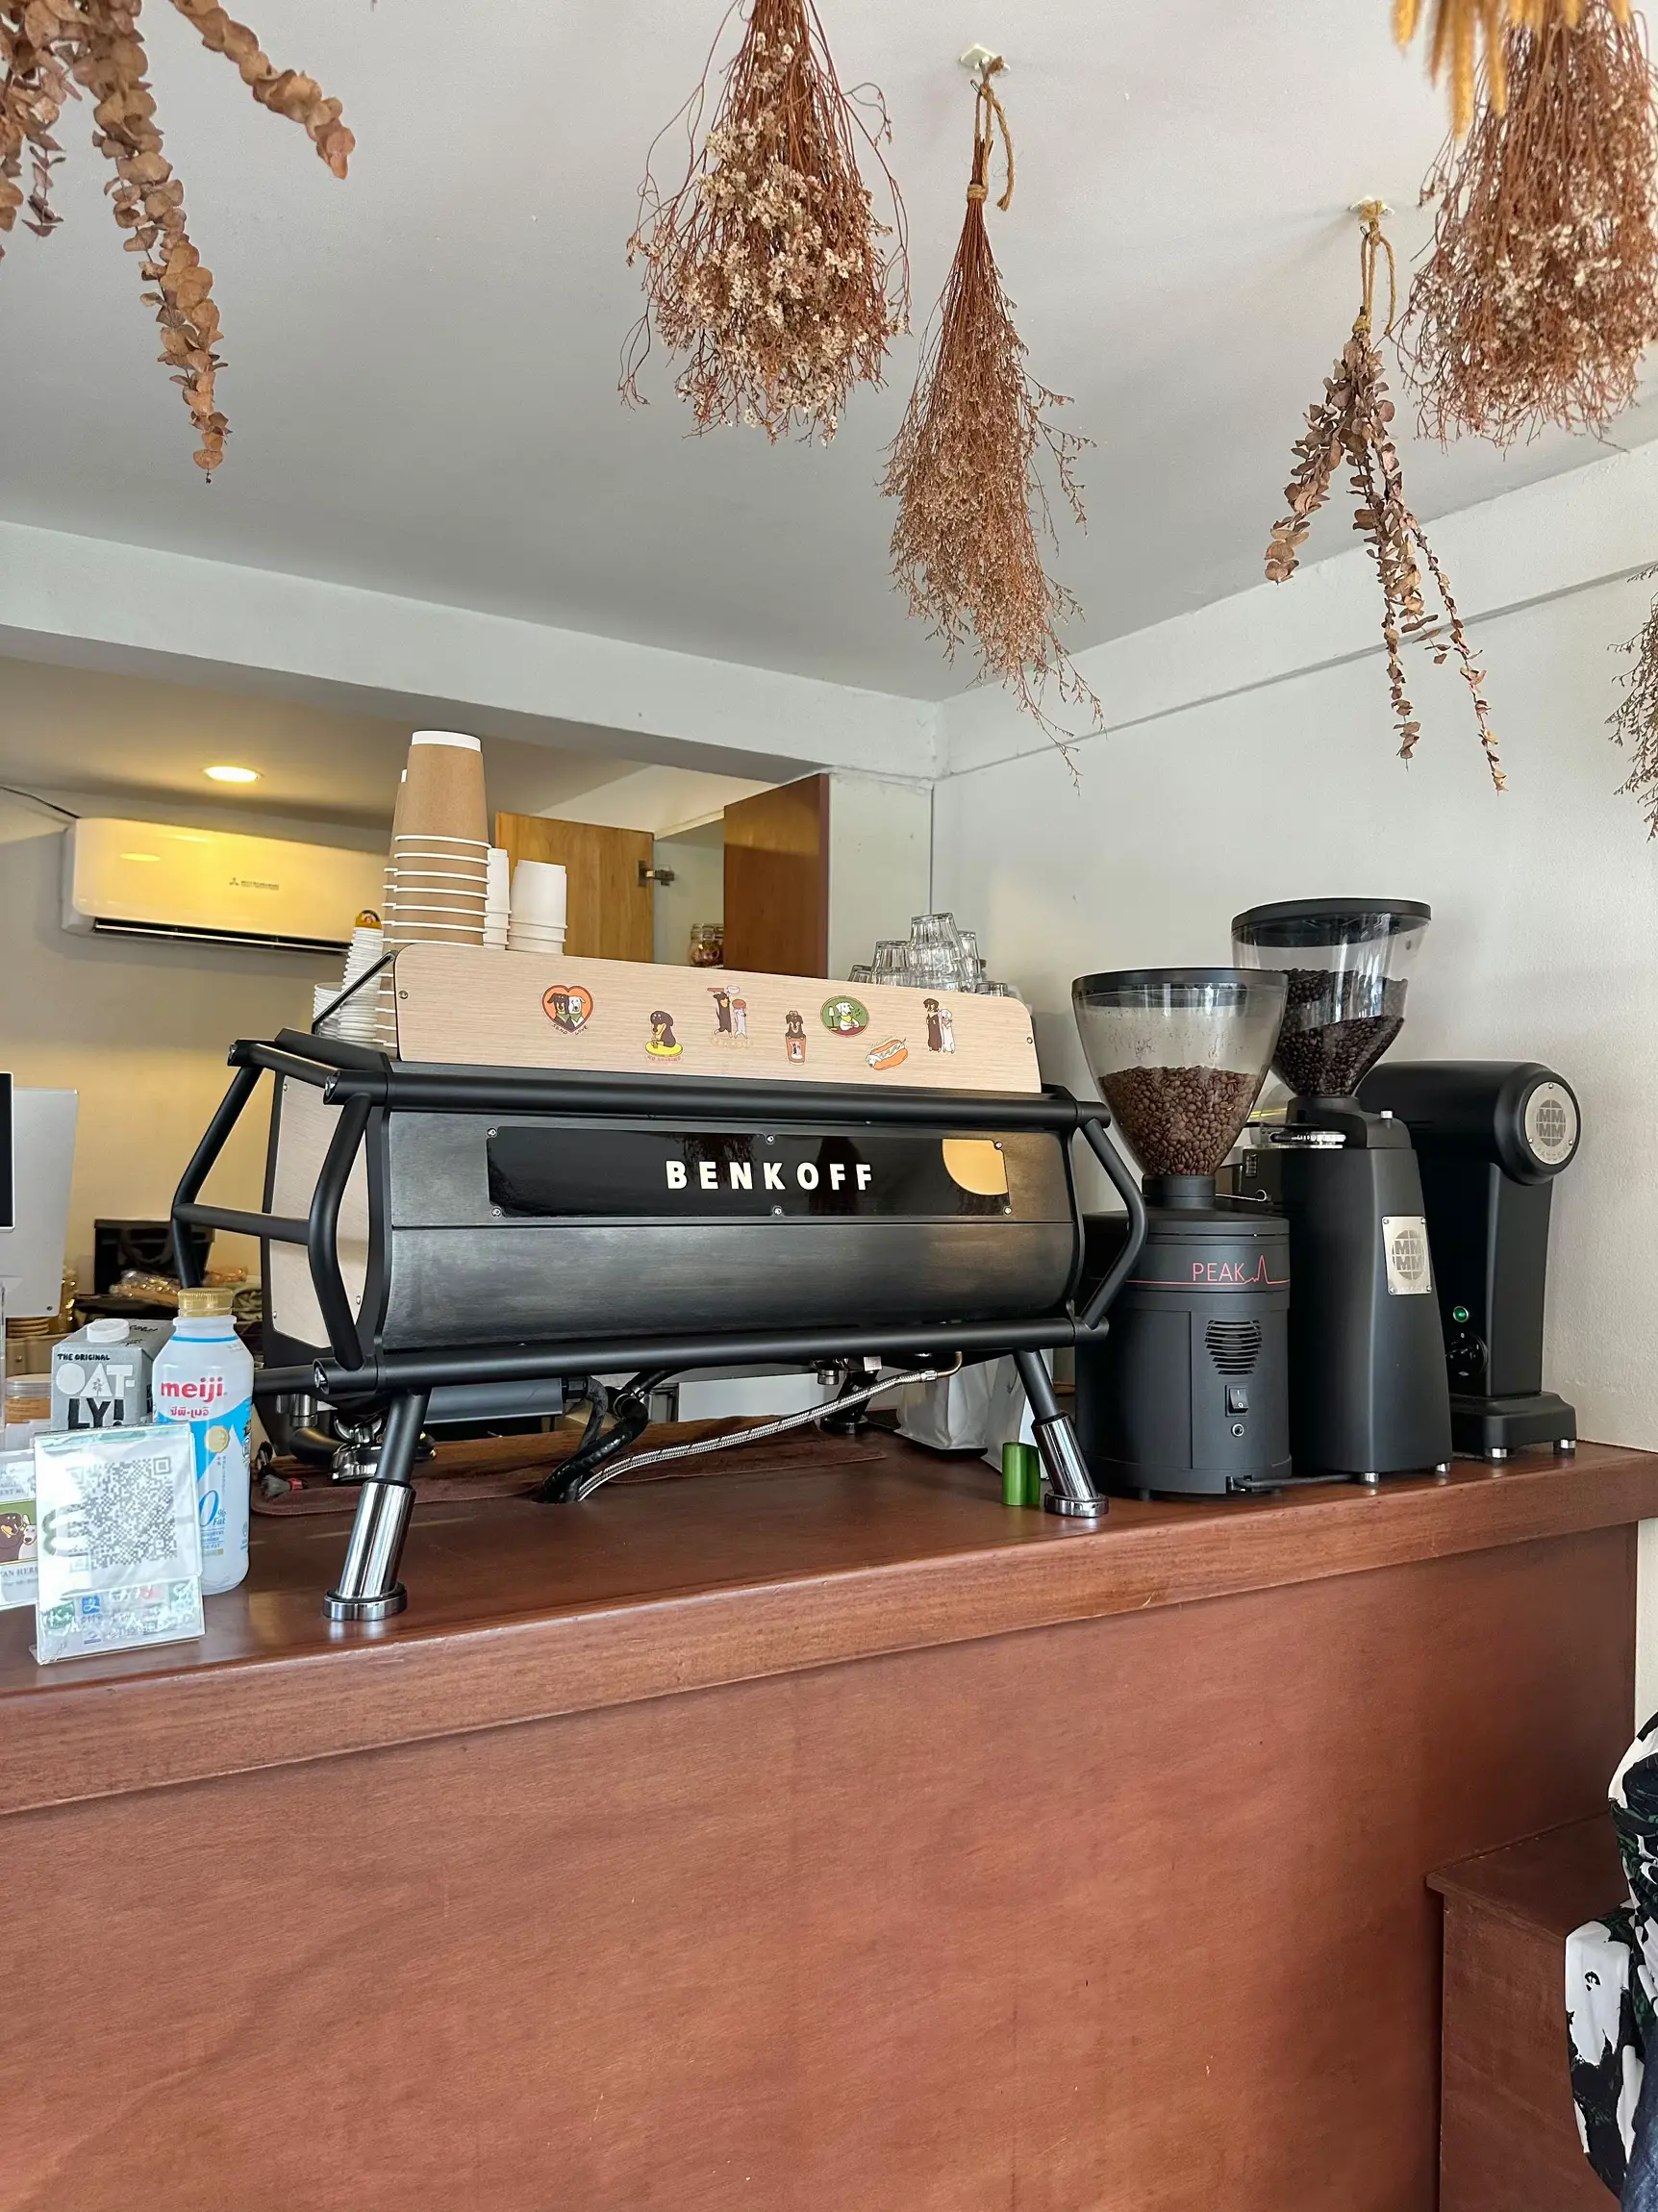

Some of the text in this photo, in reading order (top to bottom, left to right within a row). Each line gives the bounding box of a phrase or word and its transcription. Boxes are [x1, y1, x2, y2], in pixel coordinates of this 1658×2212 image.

[666, 1160, 872, 1191] BENKOFF
[1193, 1262, 1245, 1282] PEAK
[161, 1376, 224, 1403] meiji
[68, 1397, 125, 1430] LY!
[213, 1517, 226, 1527] Fat
